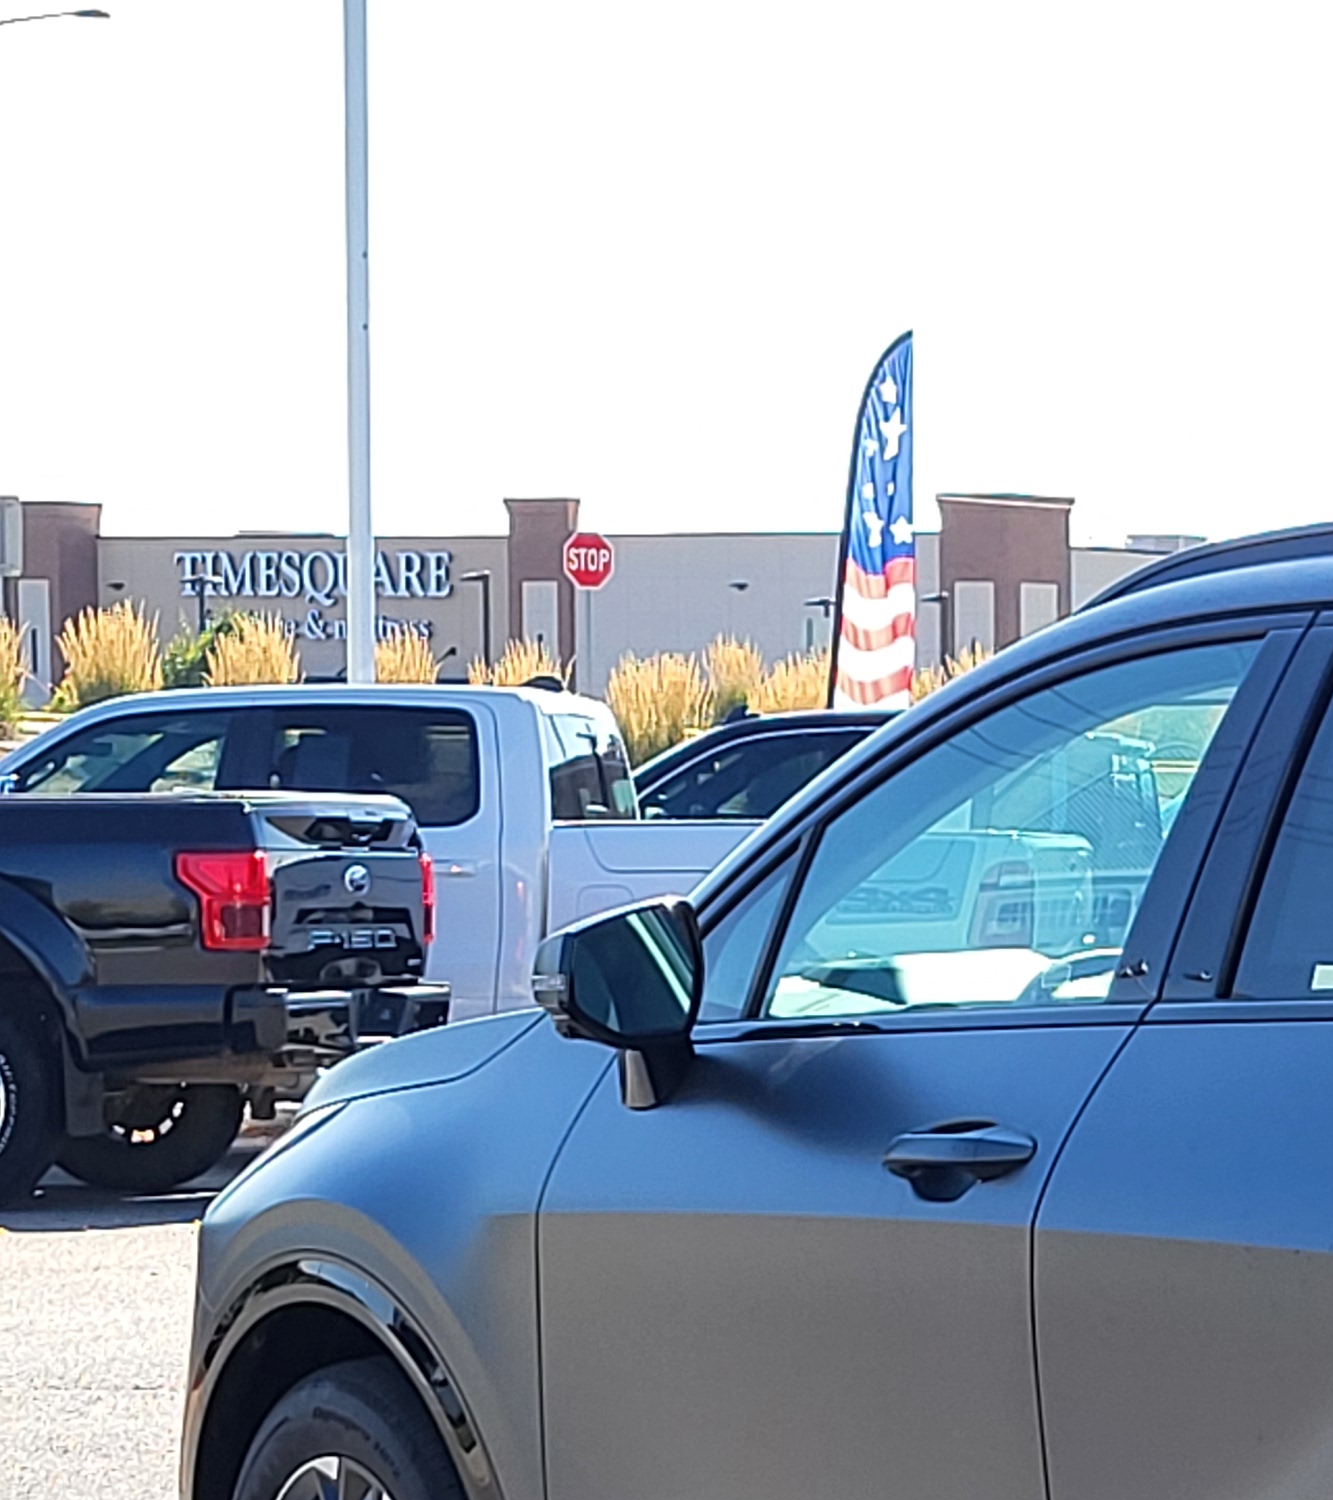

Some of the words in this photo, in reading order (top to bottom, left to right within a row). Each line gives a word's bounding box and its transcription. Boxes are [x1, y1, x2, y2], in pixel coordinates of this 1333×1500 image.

[568, 546, 611, 572] STOP
[304, 608, 330, 641] &
[308, 929, 398, 950] F-150
